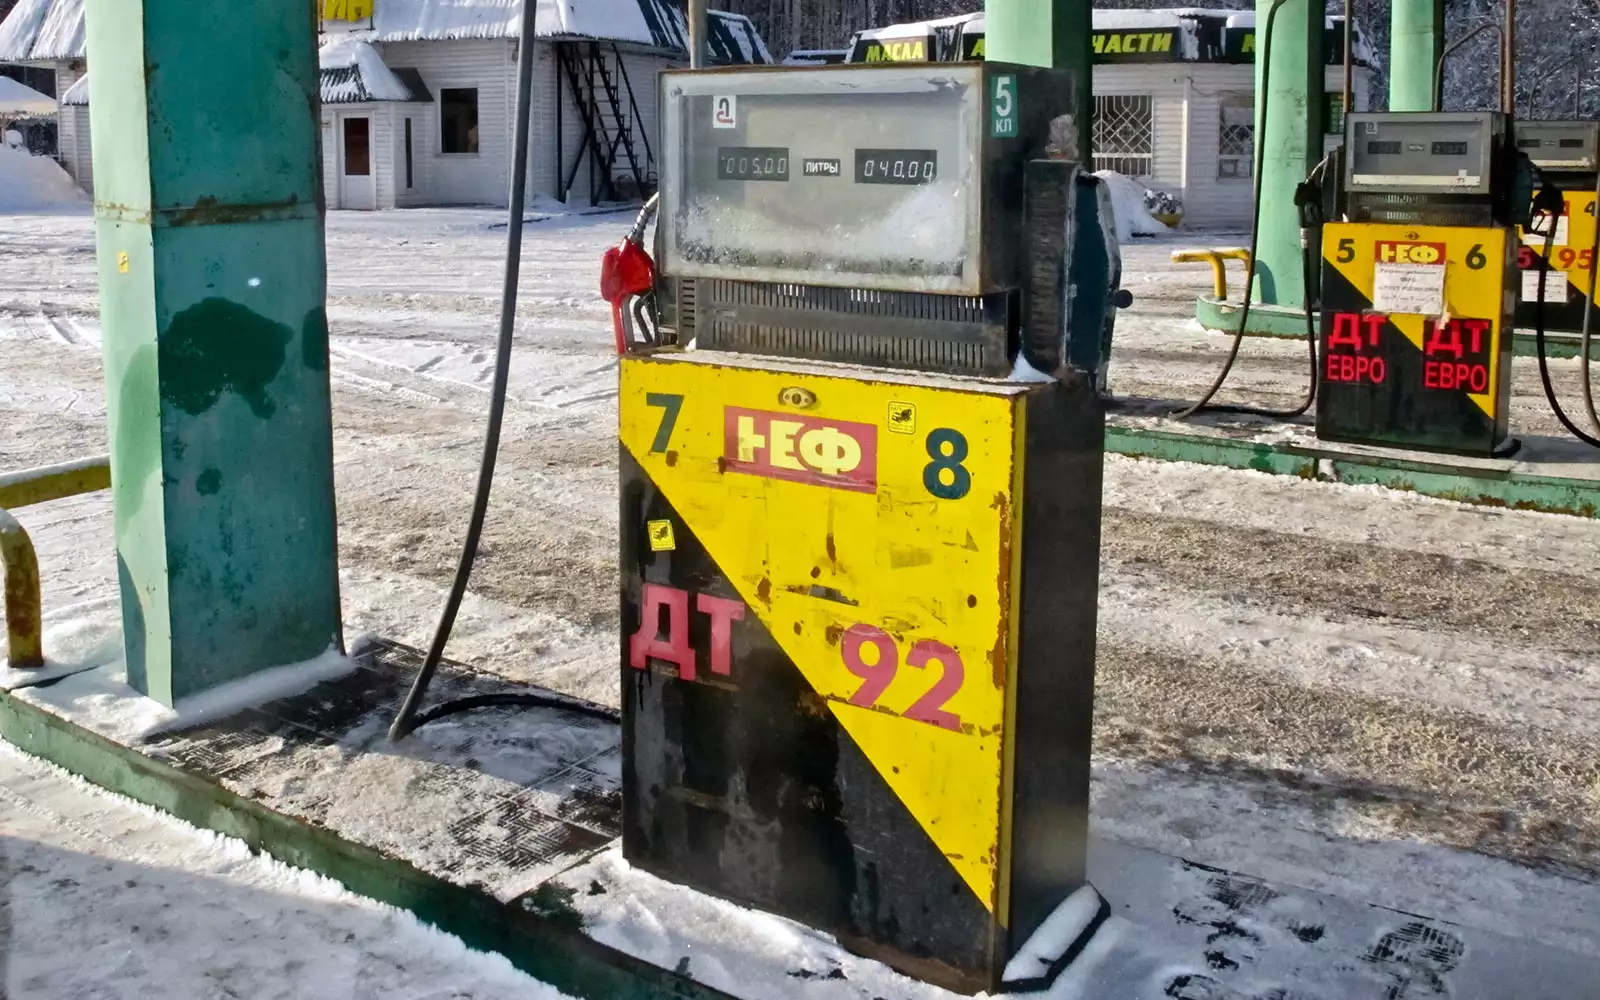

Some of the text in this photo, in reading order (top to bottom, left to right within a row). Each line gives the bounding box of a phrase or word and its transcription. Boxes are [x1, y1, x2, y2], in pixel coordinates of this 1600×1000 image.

[866, 41, 924, 62] МАСЛА
[996, 76, 1012, 117] 5
[996, 118, 1012, 133] КЛ
[805, 161, 839, 174] ЛИТРЫ
[864, 160, 933, 178] 040.00
[1336, 238, 1355, 264] 5
[1465, 243, 1487, 270] 6
[1516, 246, 1533, 269] 5
[1558, 247, 1593, 269] 95
[1328, 312, 1388, 351] ДТ
[1426, 319, 1489, 360] ДТ
[1327, 354, 1386, 384] ЕВРО
[1425, 361, 1487, 392] ЕВРО
[646, 392, 685, 454] 7
[922, 427, 972, 500] 8
[630, 582, 746, 681] ДТ
[840, 622, 966, 732] 92
